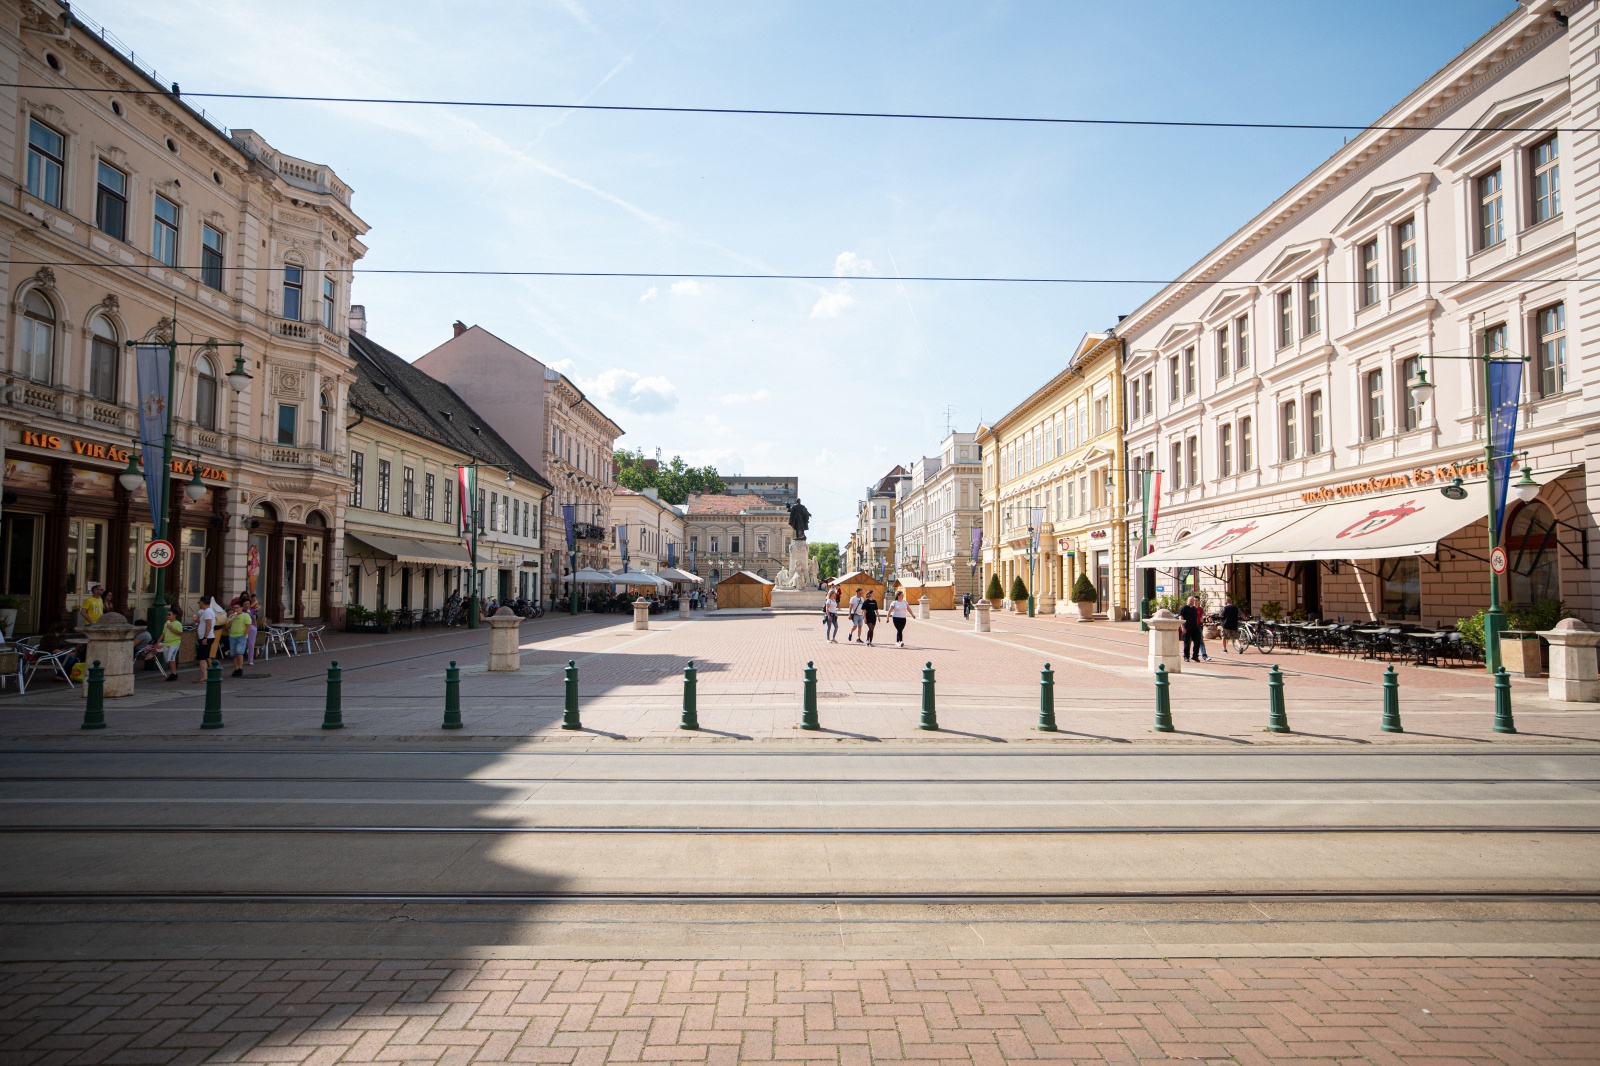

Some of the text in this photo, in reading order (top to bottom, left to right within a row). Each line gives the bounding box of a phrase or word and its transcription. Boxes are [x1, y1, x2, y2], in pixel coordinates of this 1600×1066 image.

[22, 430, 61, 450] KIS
[72, 440, 130, 463] VIRÁG
[1300, 486, 1333, 502] VIRÁG
[1334, 474, 1409, 496] CUKRÁSZDA
[1412, 466, 1434, 483] ÉS
